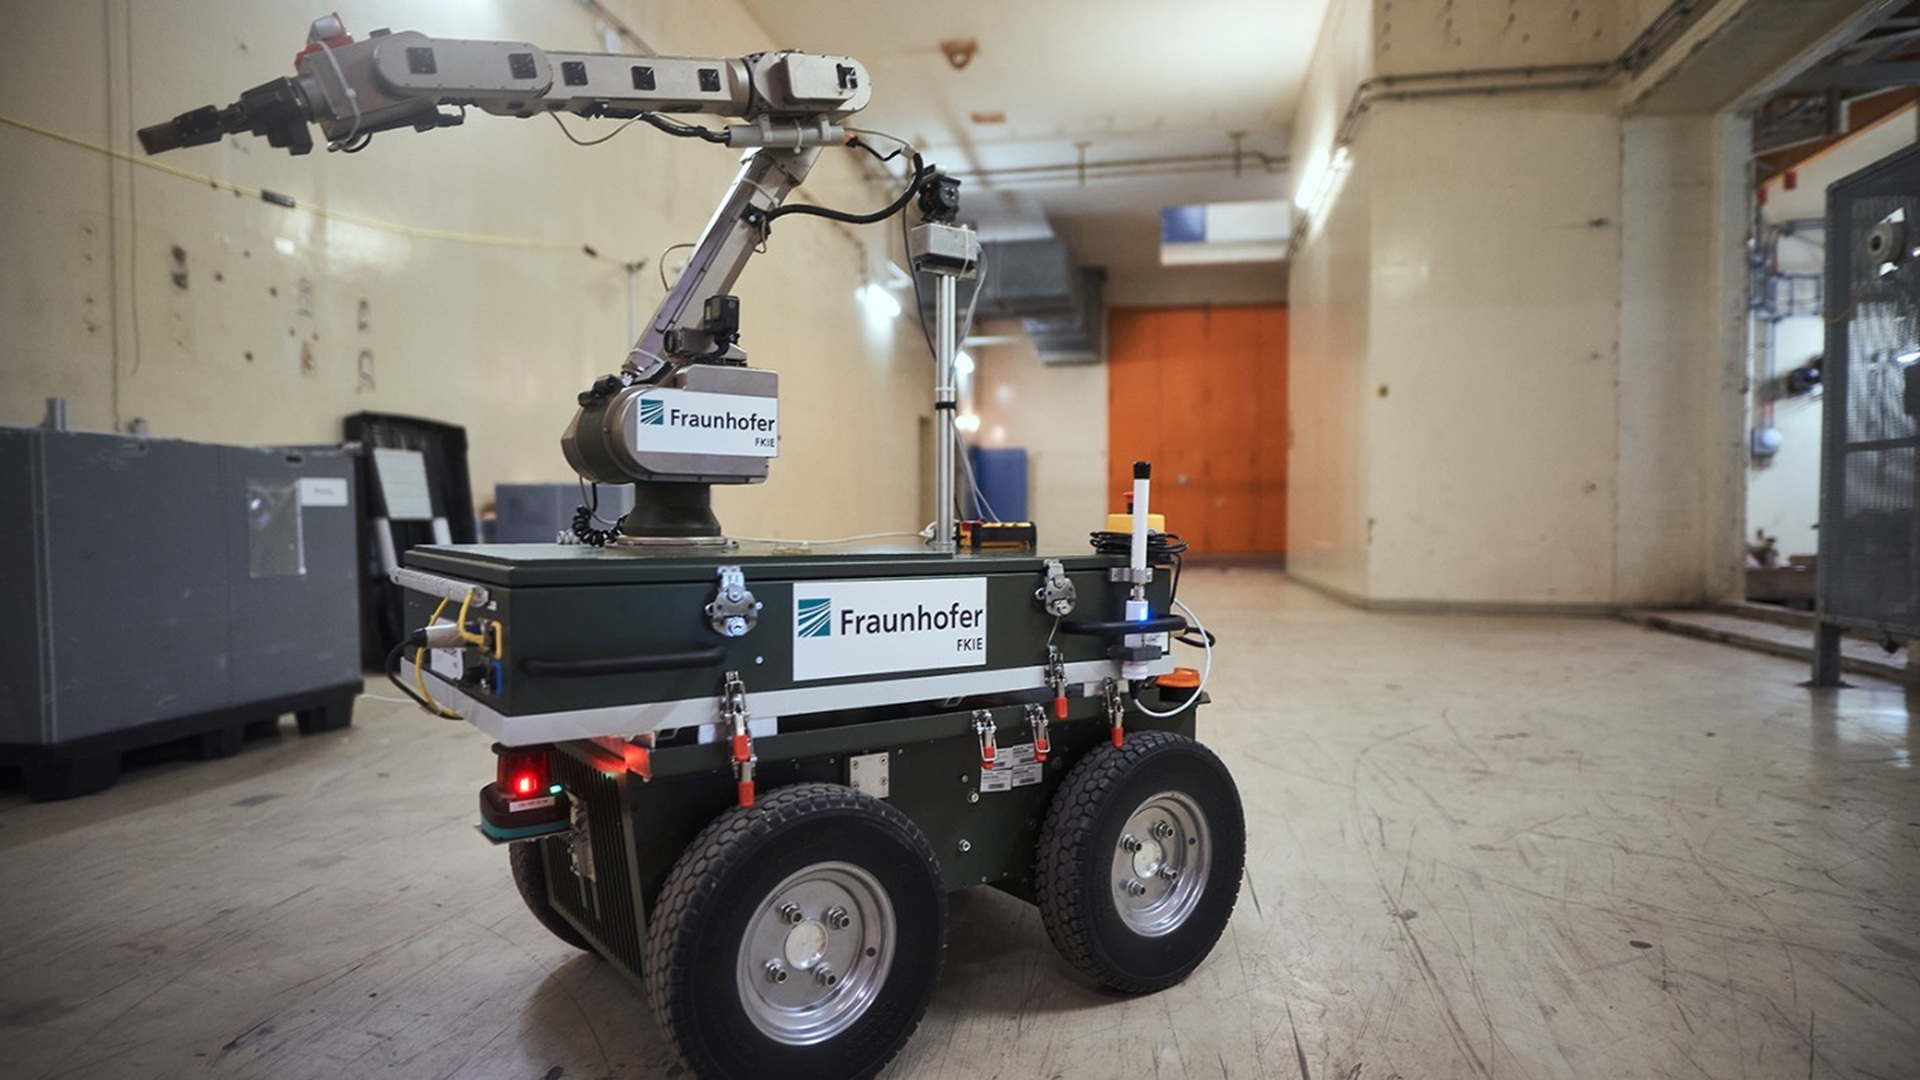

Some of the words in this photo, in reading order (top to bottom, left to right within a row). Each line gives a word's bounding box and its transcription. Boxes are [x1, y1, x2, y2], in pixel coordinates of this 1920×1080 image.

[671, 409, 775, 431] Fraunhofer
[755, 438, 775, 447] FKIE
[841, 602, 983, 636] Fraunhofer
[957, 637, 983, 651] FKIE
